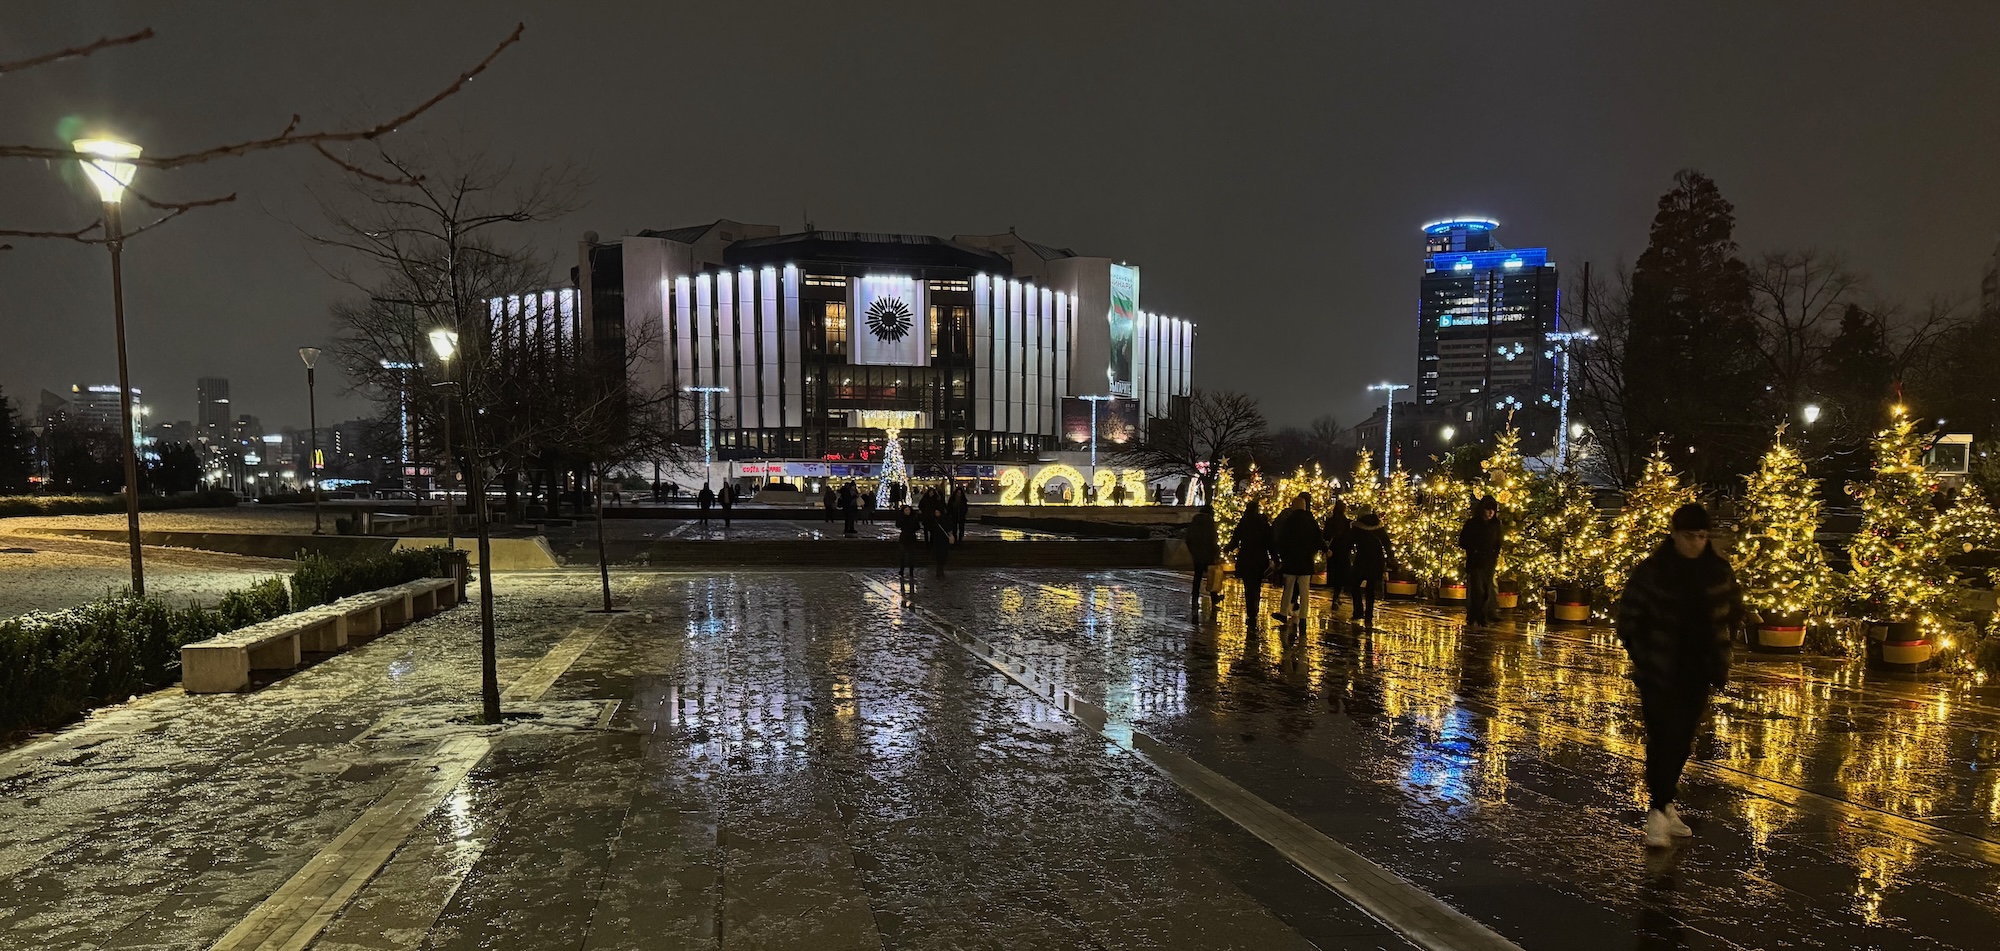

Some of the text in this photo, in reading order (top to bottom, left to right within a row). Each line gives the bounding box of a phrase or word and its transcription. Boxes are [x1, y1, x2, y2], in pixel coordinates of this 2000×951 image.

[1473, 317, 1489, 326] Grou
[761, 465, 781, 473] CFFEE
[999, 464, 1146, 507] 2025
